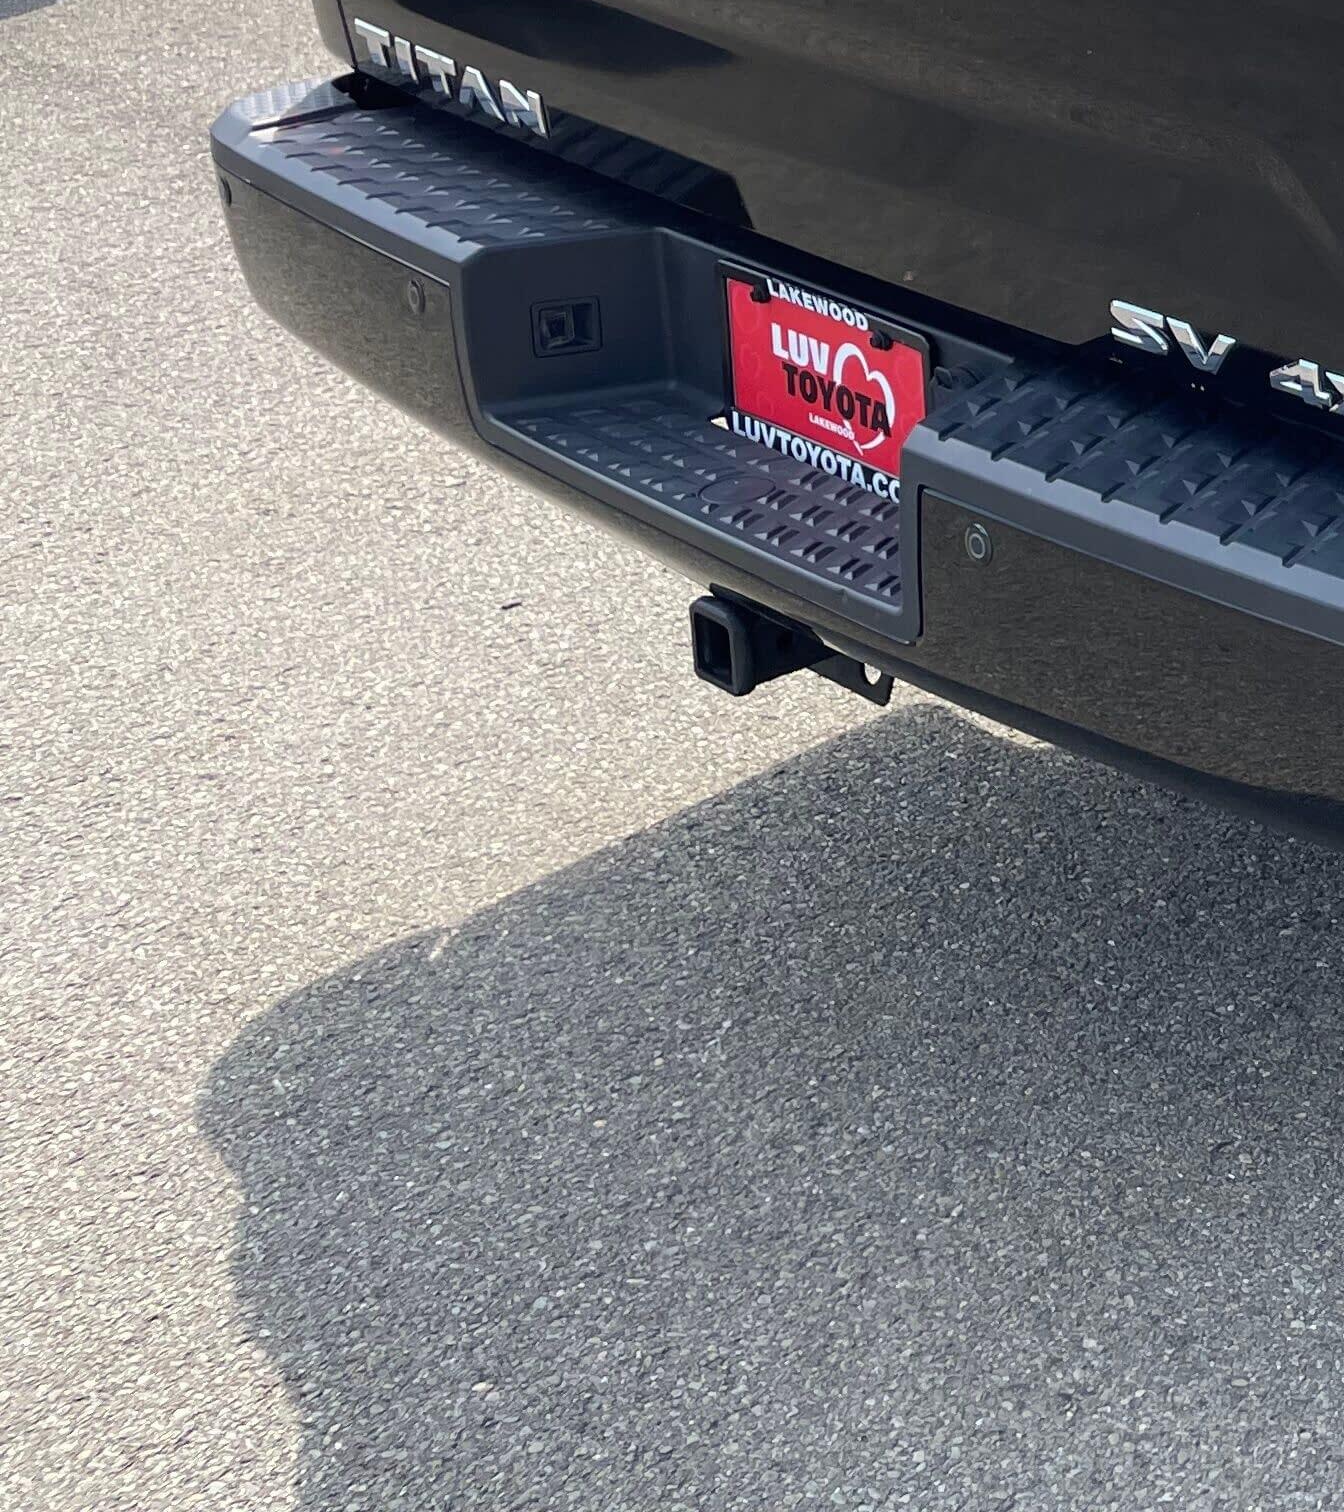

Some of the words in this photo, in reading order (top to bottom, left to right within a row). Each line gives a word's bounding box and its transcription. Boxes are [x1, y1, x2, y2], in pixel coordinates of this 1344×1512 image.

[354, 17, 549, 138] TITAN
[766, 278, 869, 332] LAKEWOOD
[1110, 299, 1236, 376] SV
[771, 322, 830, 375] LUV
[782, 361, 892, 437] TOYOTA
[808, 412, 855, 441] LAKEWOOD
